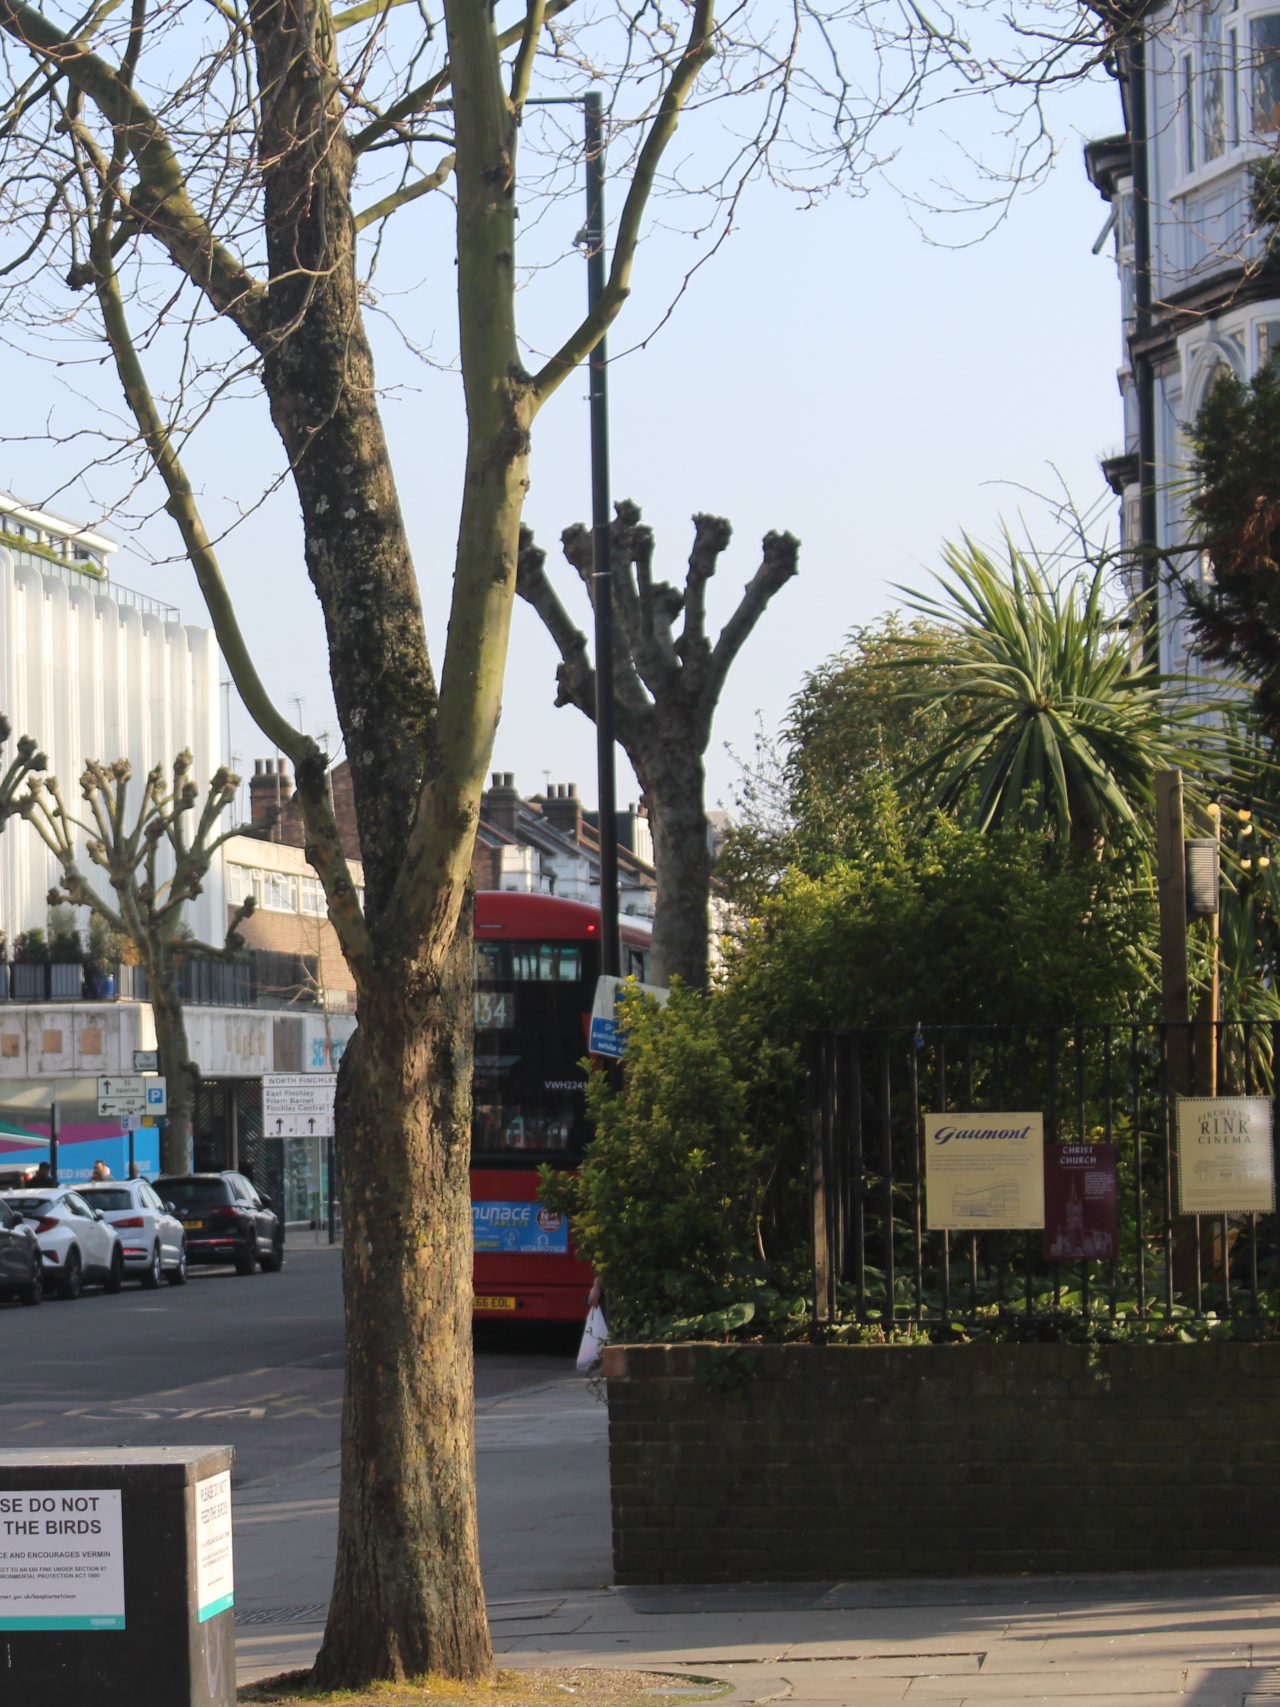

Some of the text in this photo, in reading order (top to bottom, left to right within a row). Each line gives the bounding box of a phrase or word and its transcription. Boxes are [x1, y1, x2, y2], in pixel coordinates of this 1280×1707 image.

[474, 993, 507, 1024] 134
[269, 1076, 338, 1085] NORTH FINCHLEY
[150, 1090, 162, 1103] P
[266, 1104, 326, 1112] Finchley Central
[1201, 1118, 1249, 1135] RINK
[934, 1125, 1035, 1146] Gaumont
[1198, 1135, 1252, 1145] CINEMA
[1062, 1146, 1093, 1154] CHRIST
[1060, 1156, 1097, 1165] CHURCH
[29, 1498, 56, 1513] DO
[62, 1497, 100, 1512] NOT
[4, 1520, 39, 1535] THE
[46, 1519, 102, 1535] BIRDS
[27, 1551, 80, 1559] ENCOURAGES
